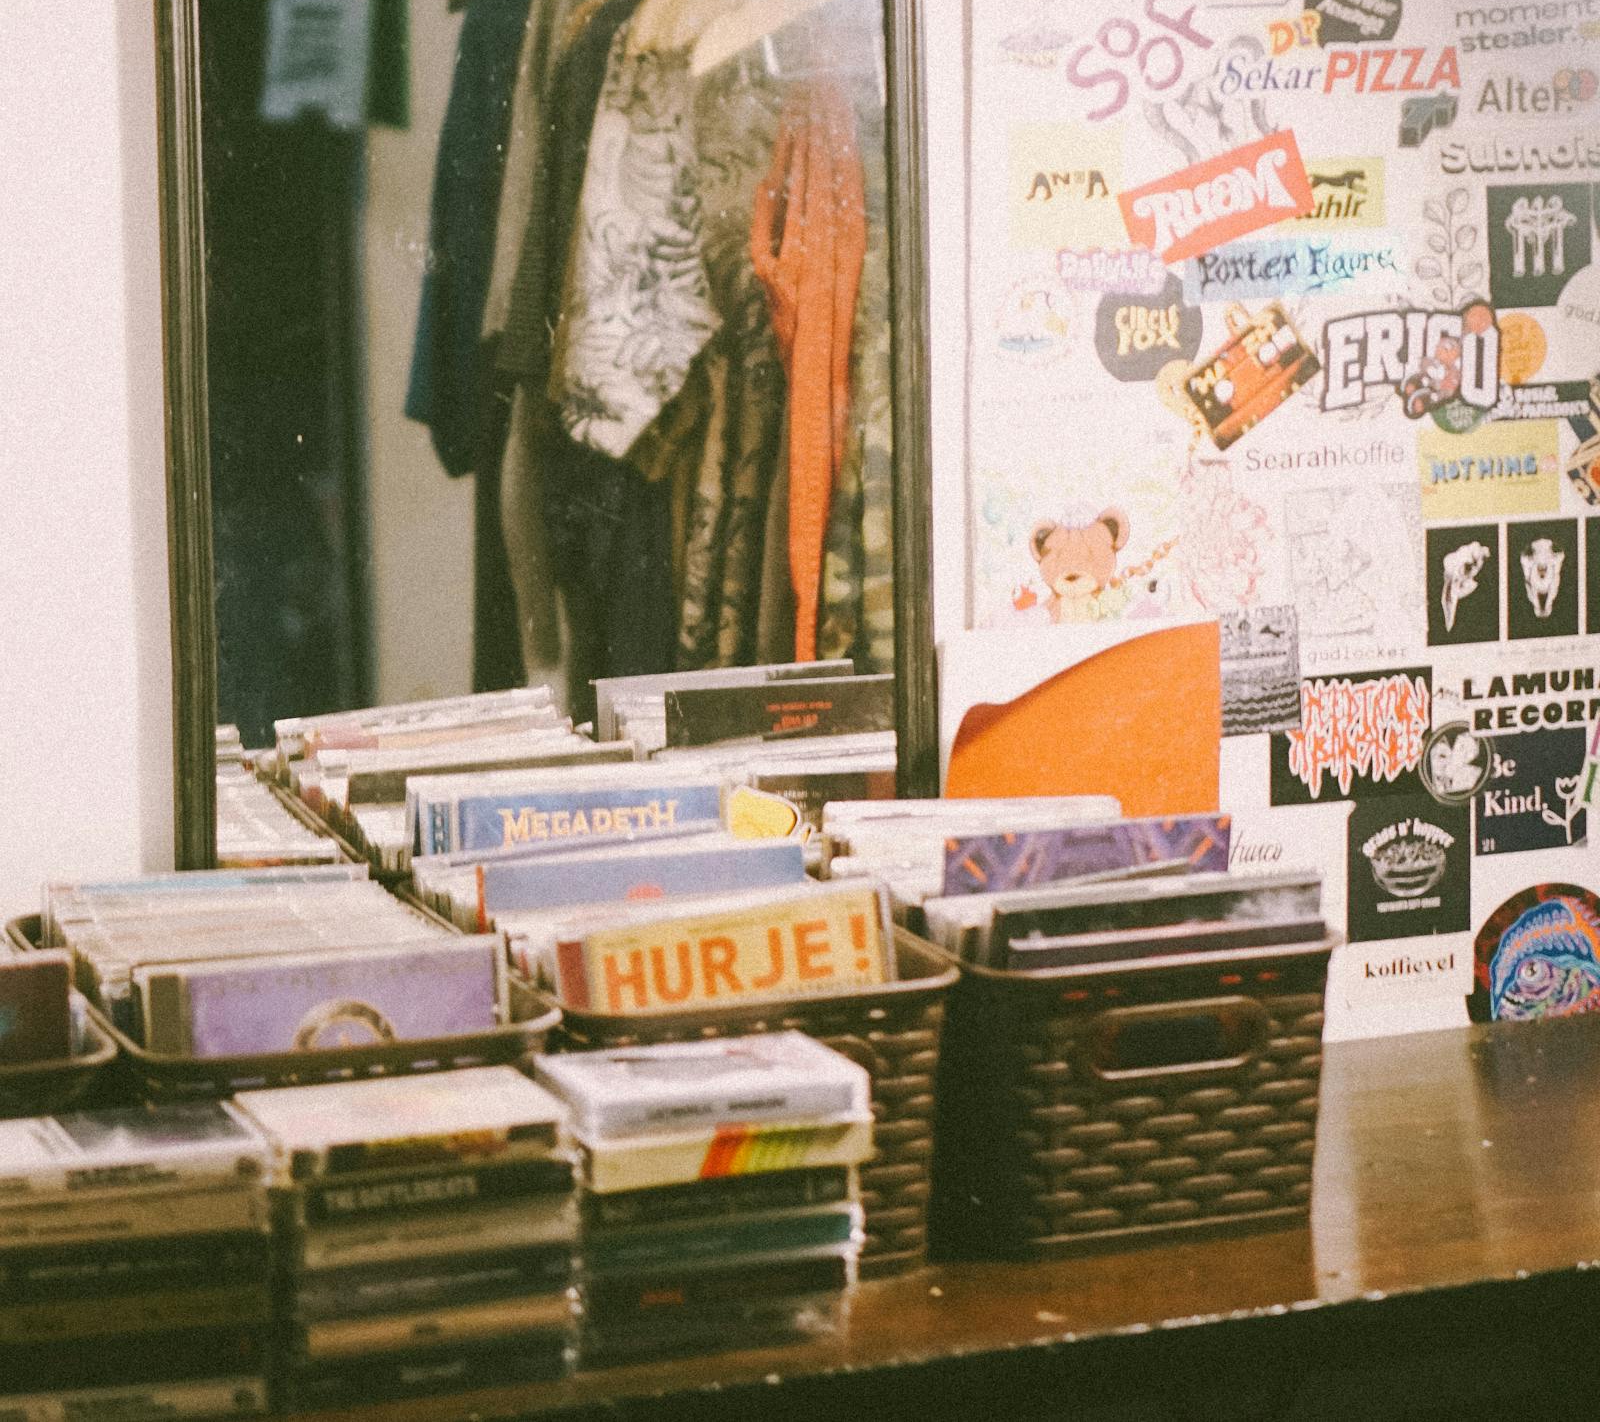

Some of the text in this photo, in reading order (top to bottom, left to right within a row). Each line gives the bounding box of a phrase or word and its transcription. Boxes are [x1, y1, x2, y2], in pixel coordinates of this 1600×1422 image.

[1322, 45, 1462, 96] PIZZA
[1198, 250, 1298, 291] Porter
[1462, 667, 1600, 701] LAMUN
[1483, 784, 1549, 818] Kind.
[497, 797, 680, 848] MEGADETH
